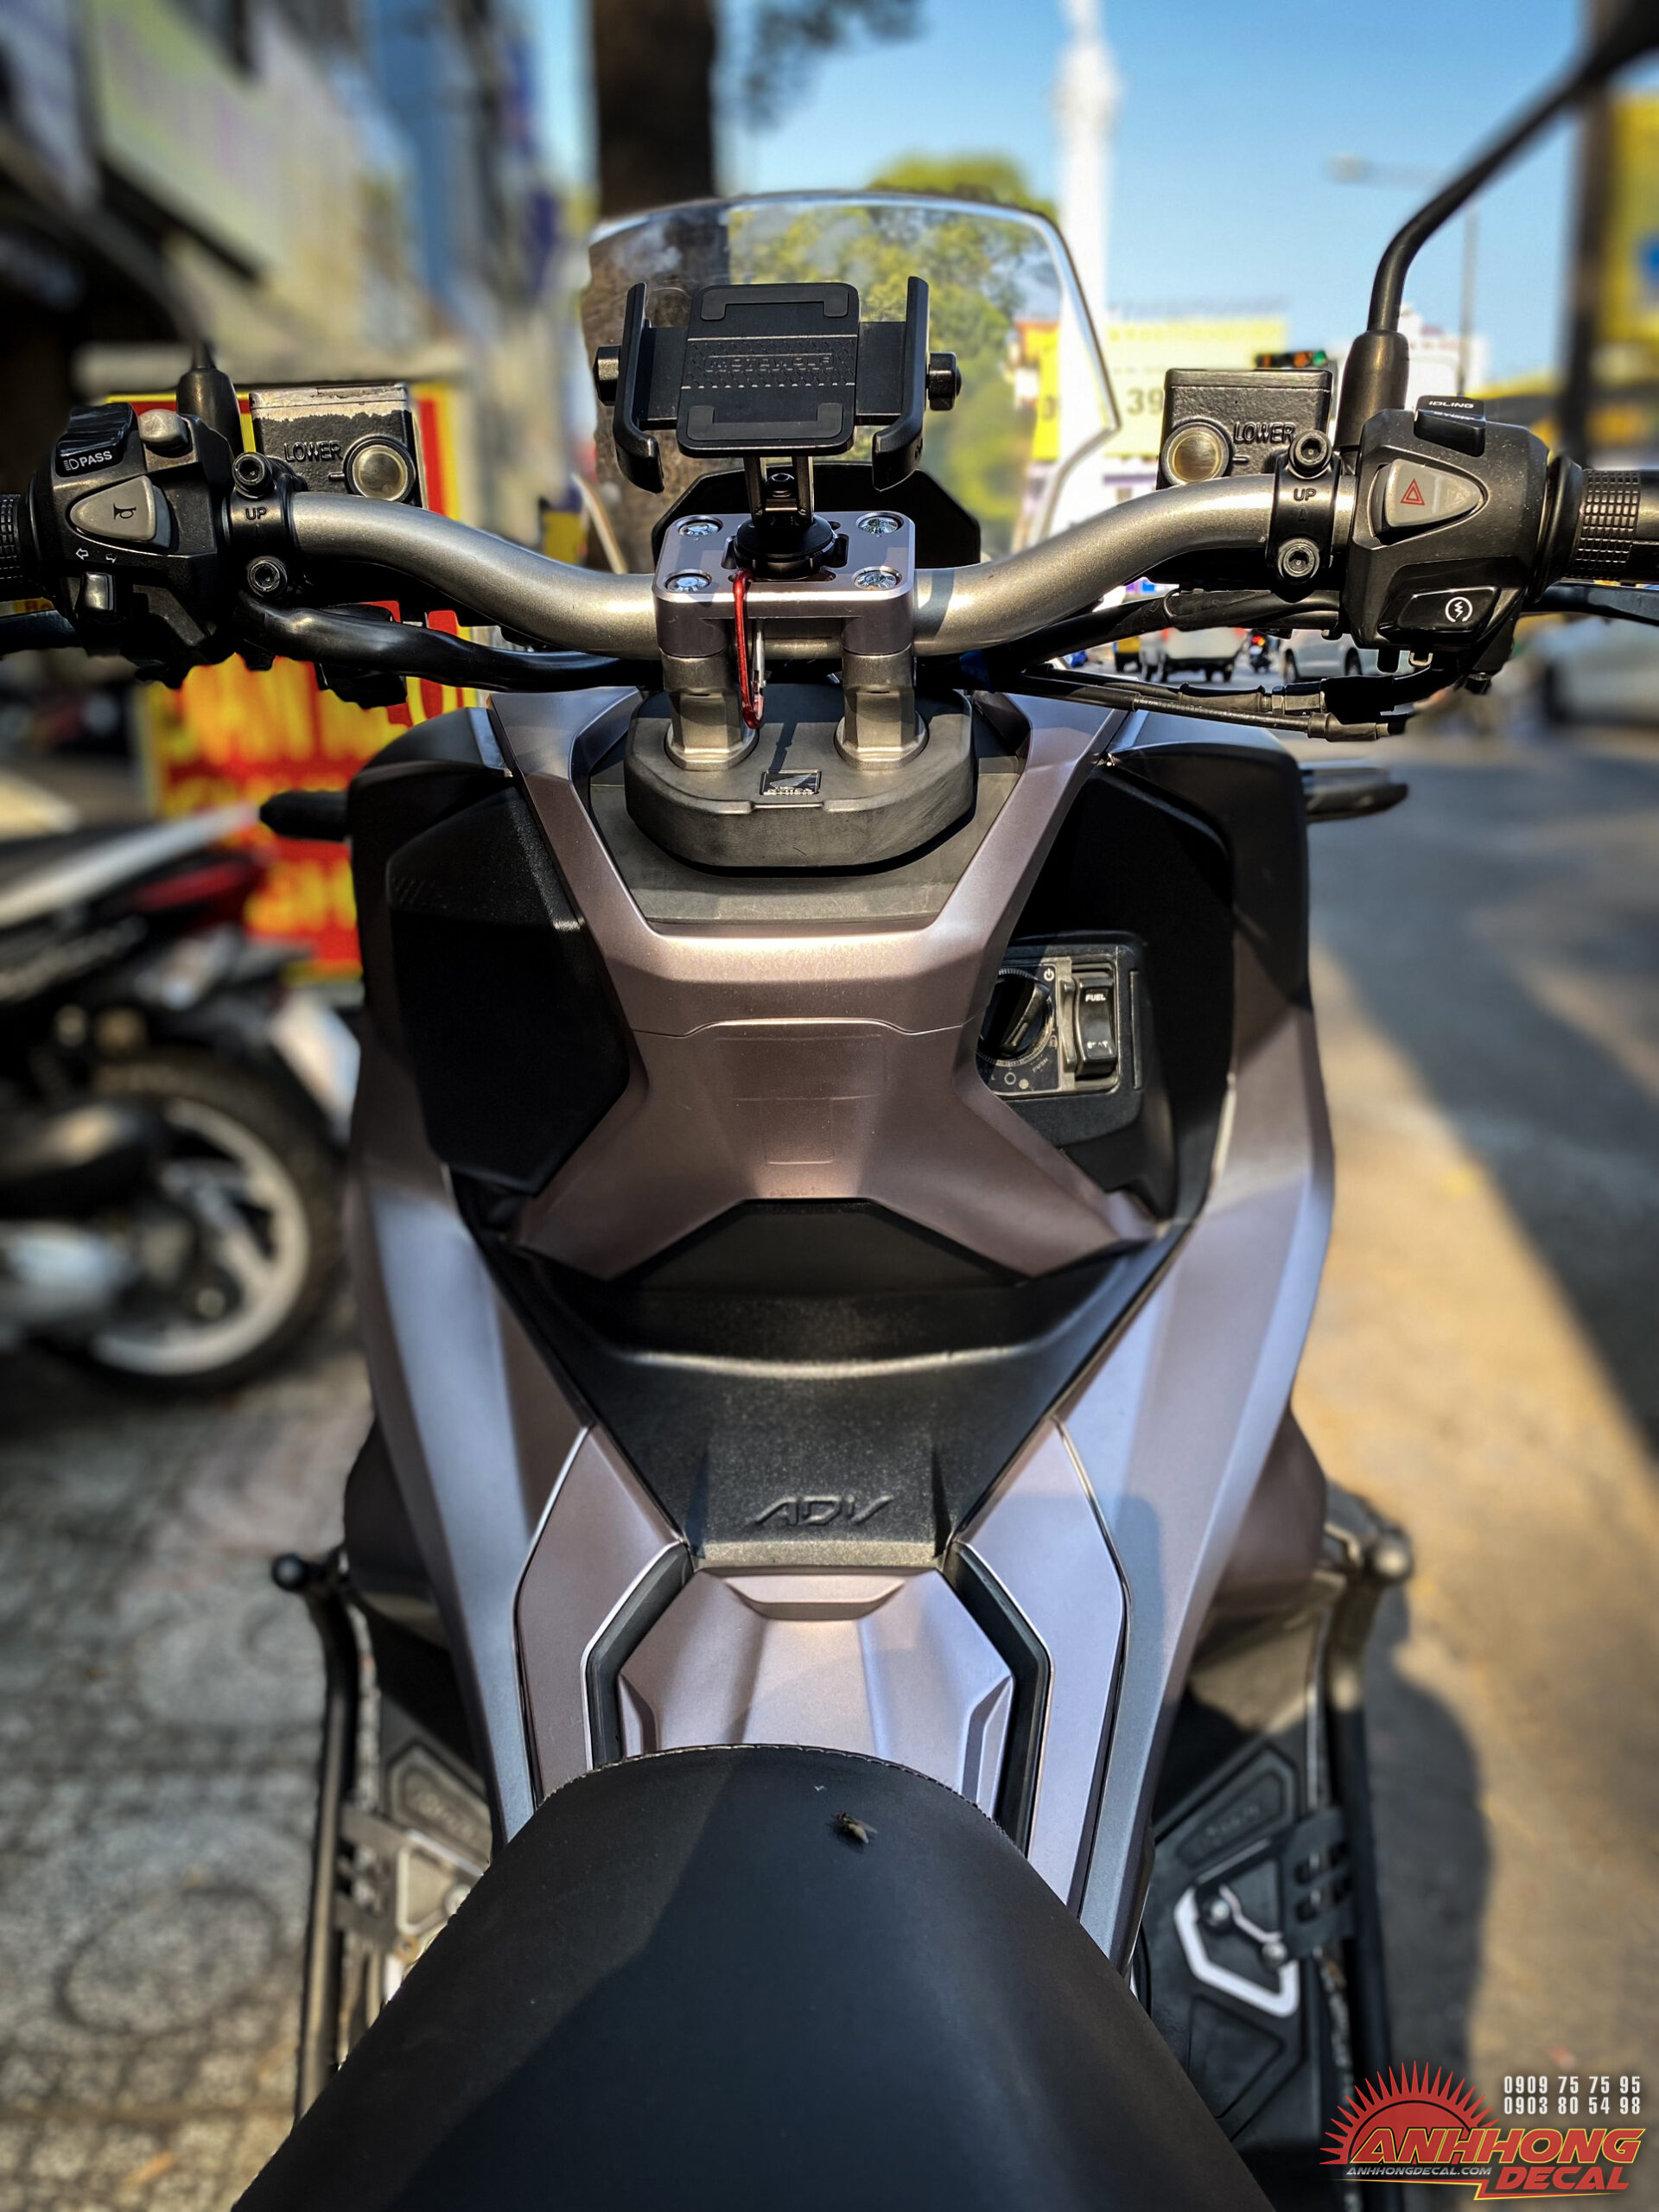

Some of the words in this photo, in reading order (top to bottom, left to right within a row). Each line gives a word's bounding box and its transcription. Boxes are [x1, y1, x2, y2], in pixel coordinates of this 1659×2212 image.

[1428, 400, 1474, 409] IDLING
[1233, 422, 1297, 445] LOWER
[283, 439, 344, 462] LOWER
[79, 450, 112, 467] PASS
[1294, 487, 1317, 501] UP
[245, 506, 267, 520] UP
[1085, 993, 1106, 1002] FUEL
[747, 1494, 895, 1527] ADV
